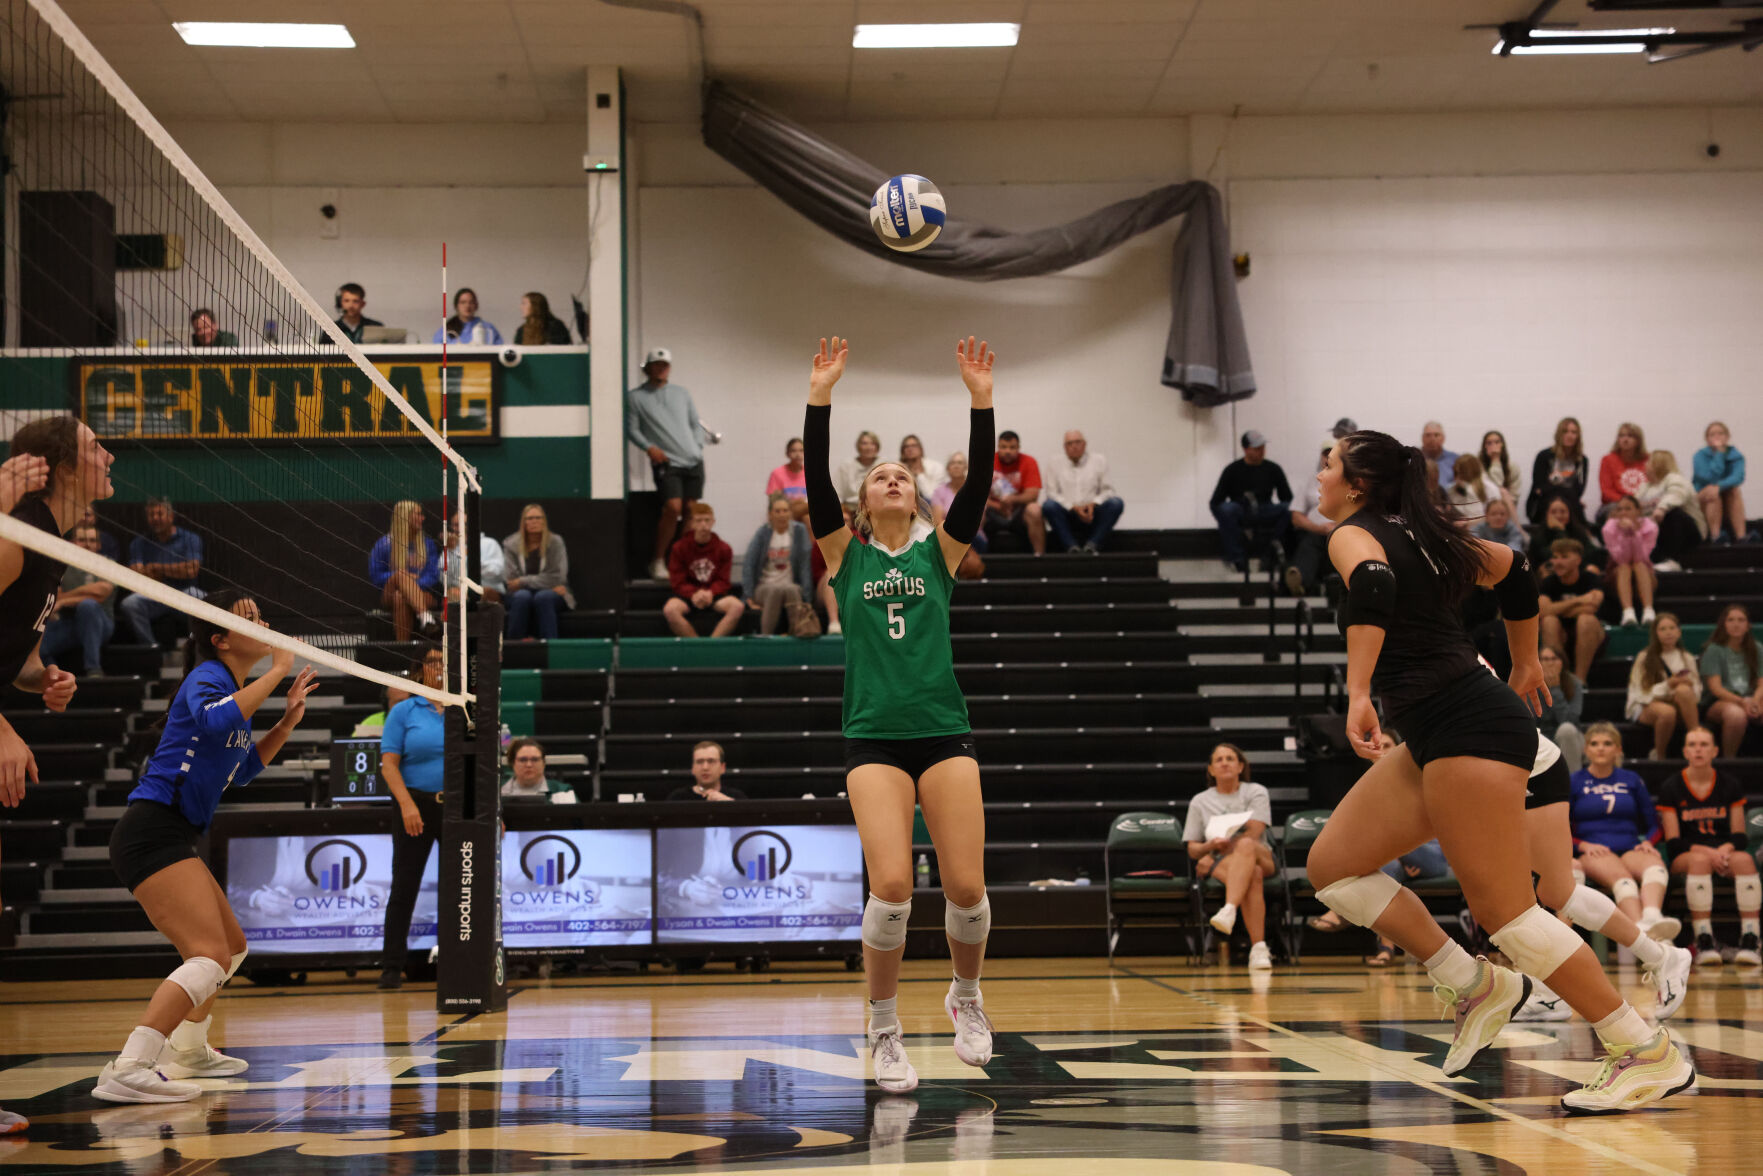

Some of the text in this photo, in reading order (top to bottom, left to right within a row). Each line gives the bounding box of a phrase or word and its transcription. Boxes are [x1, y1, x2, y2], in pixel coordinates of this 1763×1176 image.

[889, 185, 905, 227] molten
[85, 366, 489, 436] CENTRAL
[863, 577, 925, 600] SCOTUS
[33, 593, 55, 632] 12
[887, 602, 906, 640] 5
[355, 752, 368, 773] 8
[349, 781, 373, 793] 0 1
[1602, 794, 1616, 814] 7
[458, 841, 473, 941] sports imports
[510, 889, 594, 905] OWENS
[722, 885, 806, 900] OWENS
[294, 895, 380, 910] OWENS
[502, 920, 647, 932] wain Owens 402-564-7197
[664, 915, 859, 929] Tyson & Dwain Owens 402-564-7197
[266, 930, 273, 938] &
[276, 929, 307, 938] Dwain
[308, 927, 342, 937] Owens
